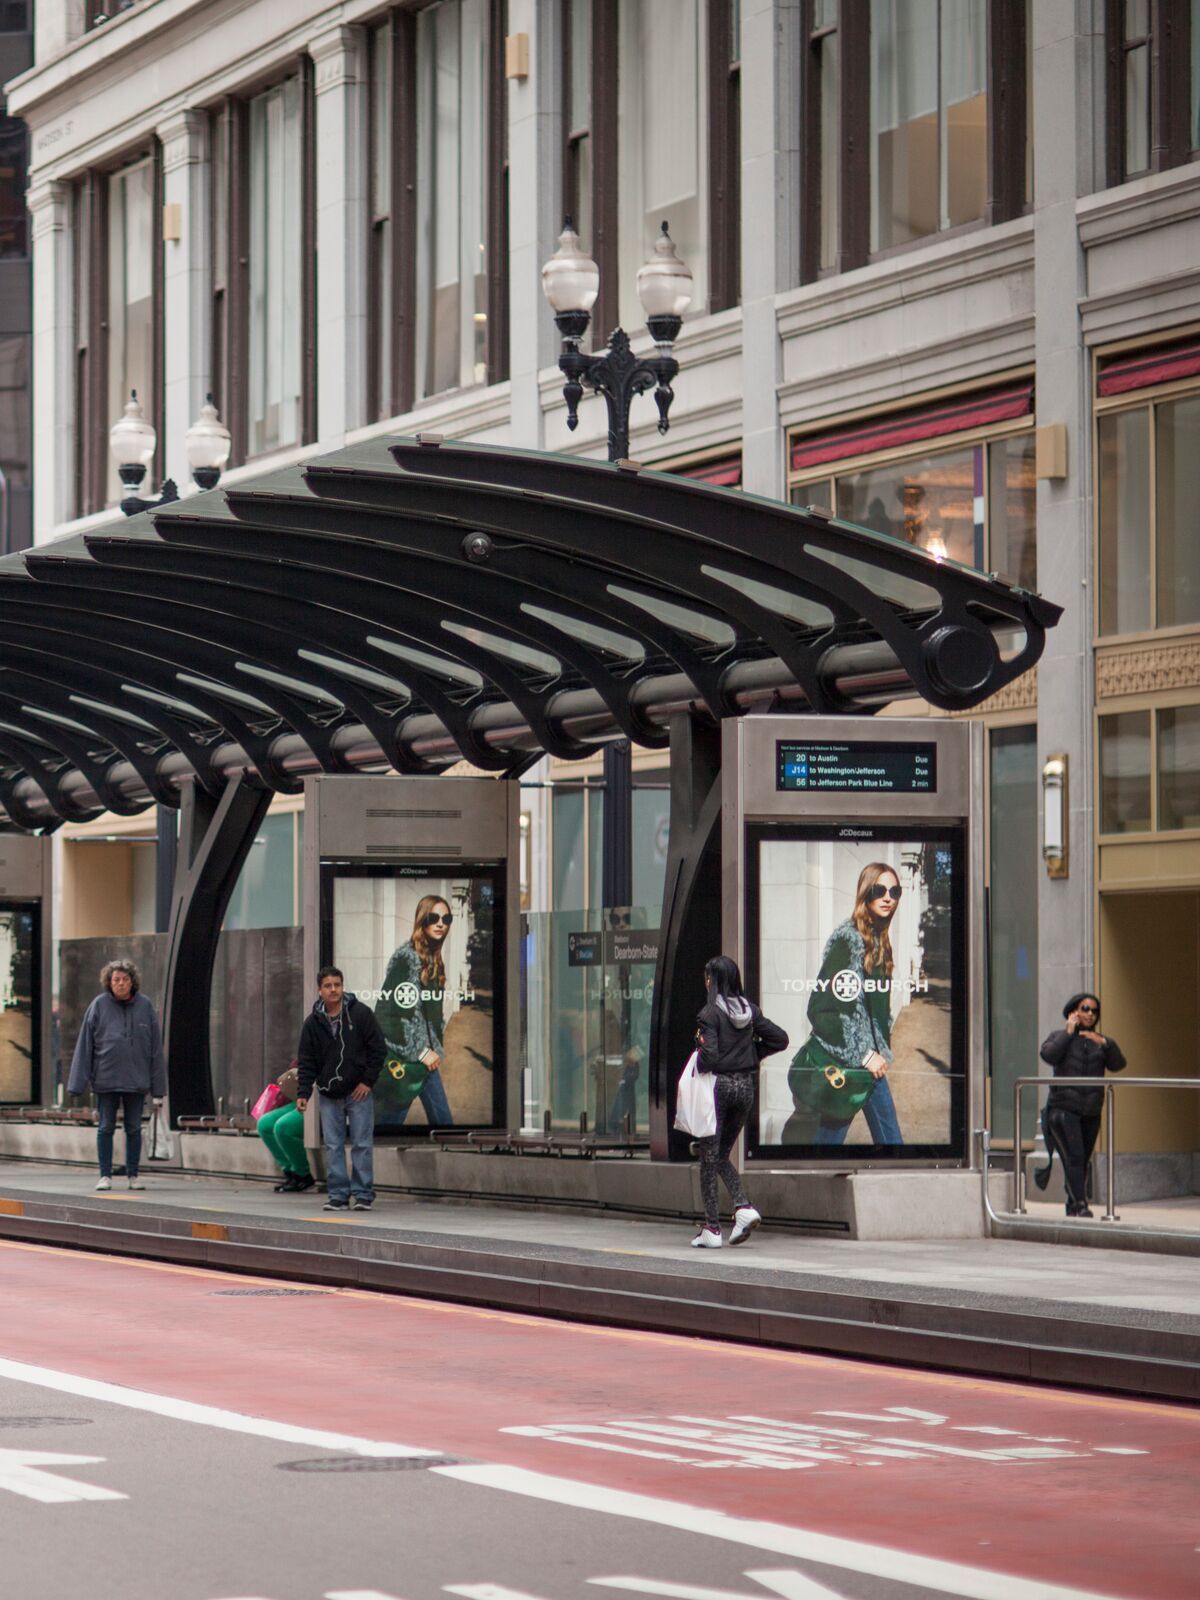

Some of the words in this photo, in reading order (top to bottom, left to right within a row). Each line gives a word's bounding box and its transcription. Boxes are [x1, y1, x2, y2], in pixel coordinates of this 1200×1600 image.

[795, 753, 806, 762] 20
[817, 754, 838, 762] Austin
[915, 755, 929, 763] Due
[791, 766, 806, 774] J14
[809, 766, 817, 774] to
[817, 766, 886, 776] Washington/Jefferson
[915, 767, 929, 775] Due
[796, 778, 806, 786] 56
[817, 779, 847, 787] Jefferson
[847, 779, 862, 787] Park
[863, 779, 878, 787] Blue
[879, 779, 893, 787] Line
[911, 780, 917, 788] 2
[917, 780, 929, 788] min
[839, 829, 873, 837] JCDecaux
[614, 944, 658, 960] Dearborn-State
[781, 979, 831, 993] TORY
[863, 979, 928, 993] BURCH
[421, 990, 475, 1001] BURCH
